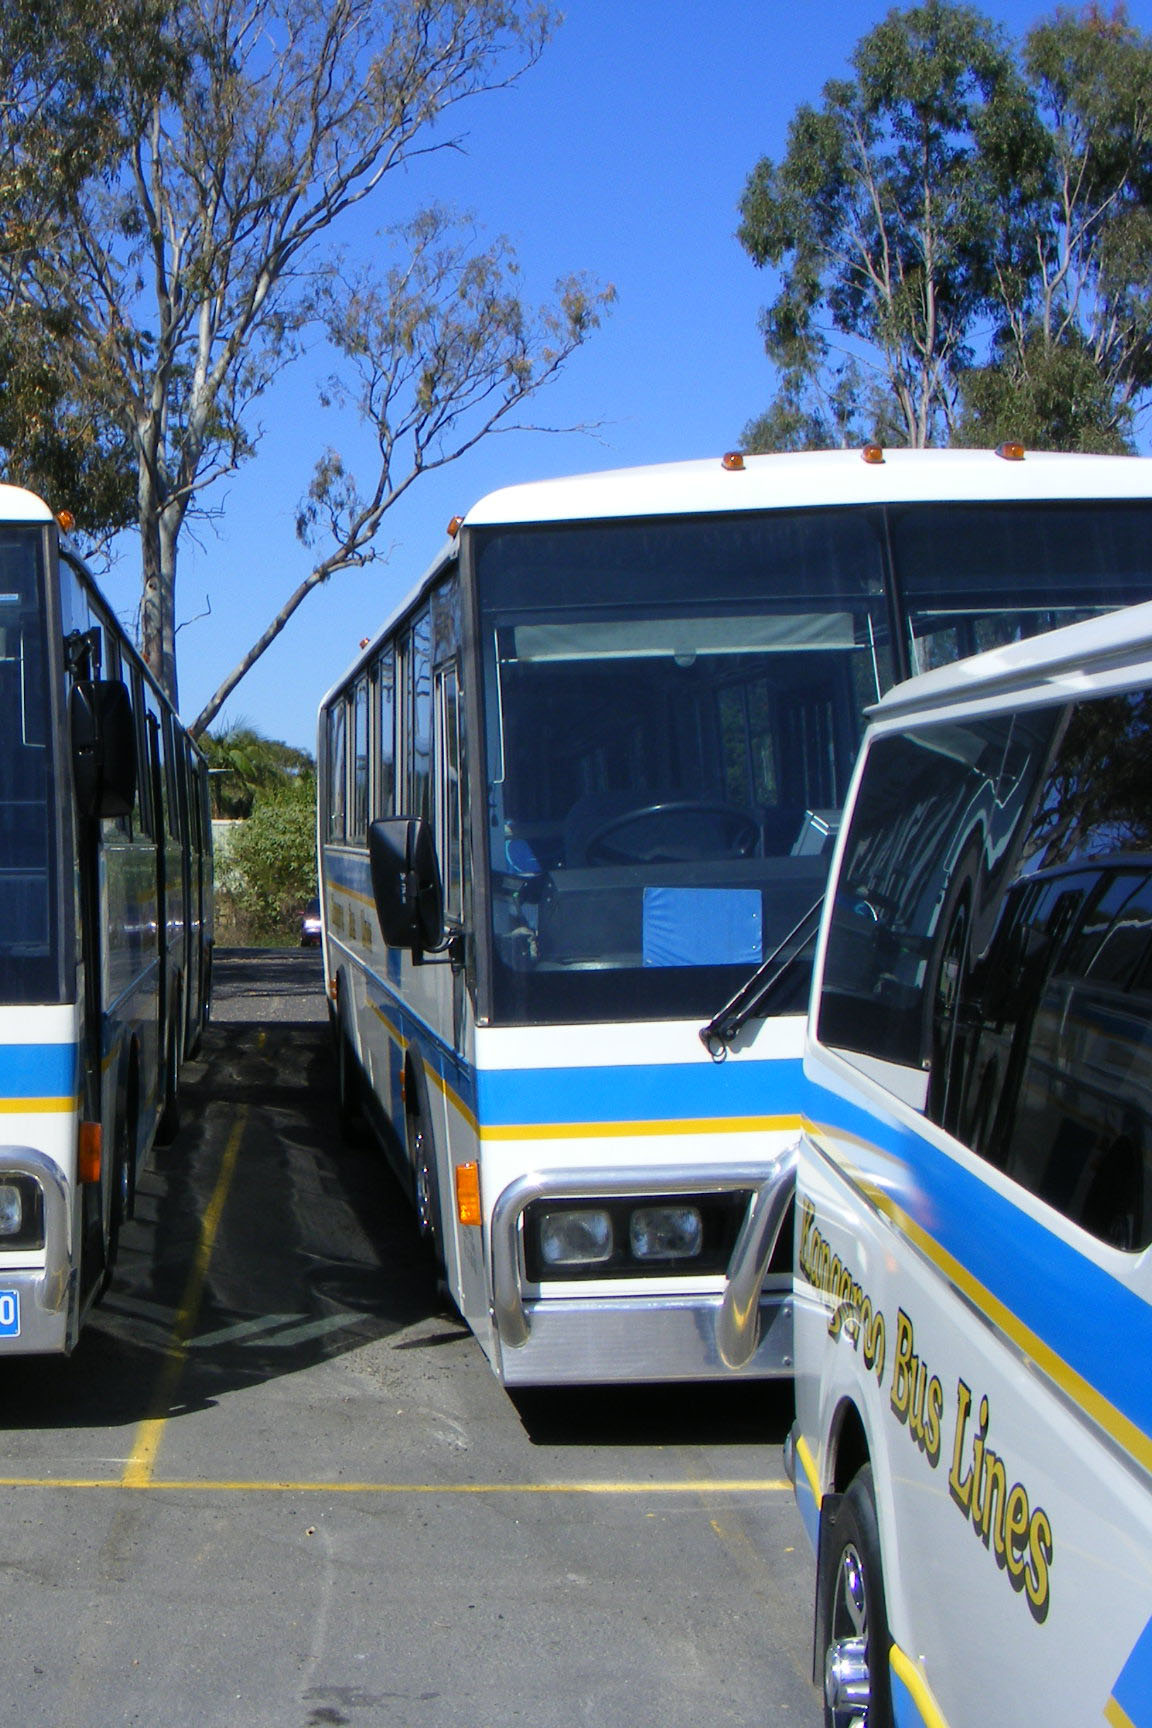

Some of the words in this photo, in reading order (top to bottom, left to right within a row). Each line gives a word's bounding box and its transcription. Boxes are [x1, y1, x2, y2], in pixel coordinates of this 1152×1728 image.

[800, 1193, 885, 1388] Kangaroo
[890, 1306, 943, 1468] Bus
[949, 1378, 1053, 1625] Lines
